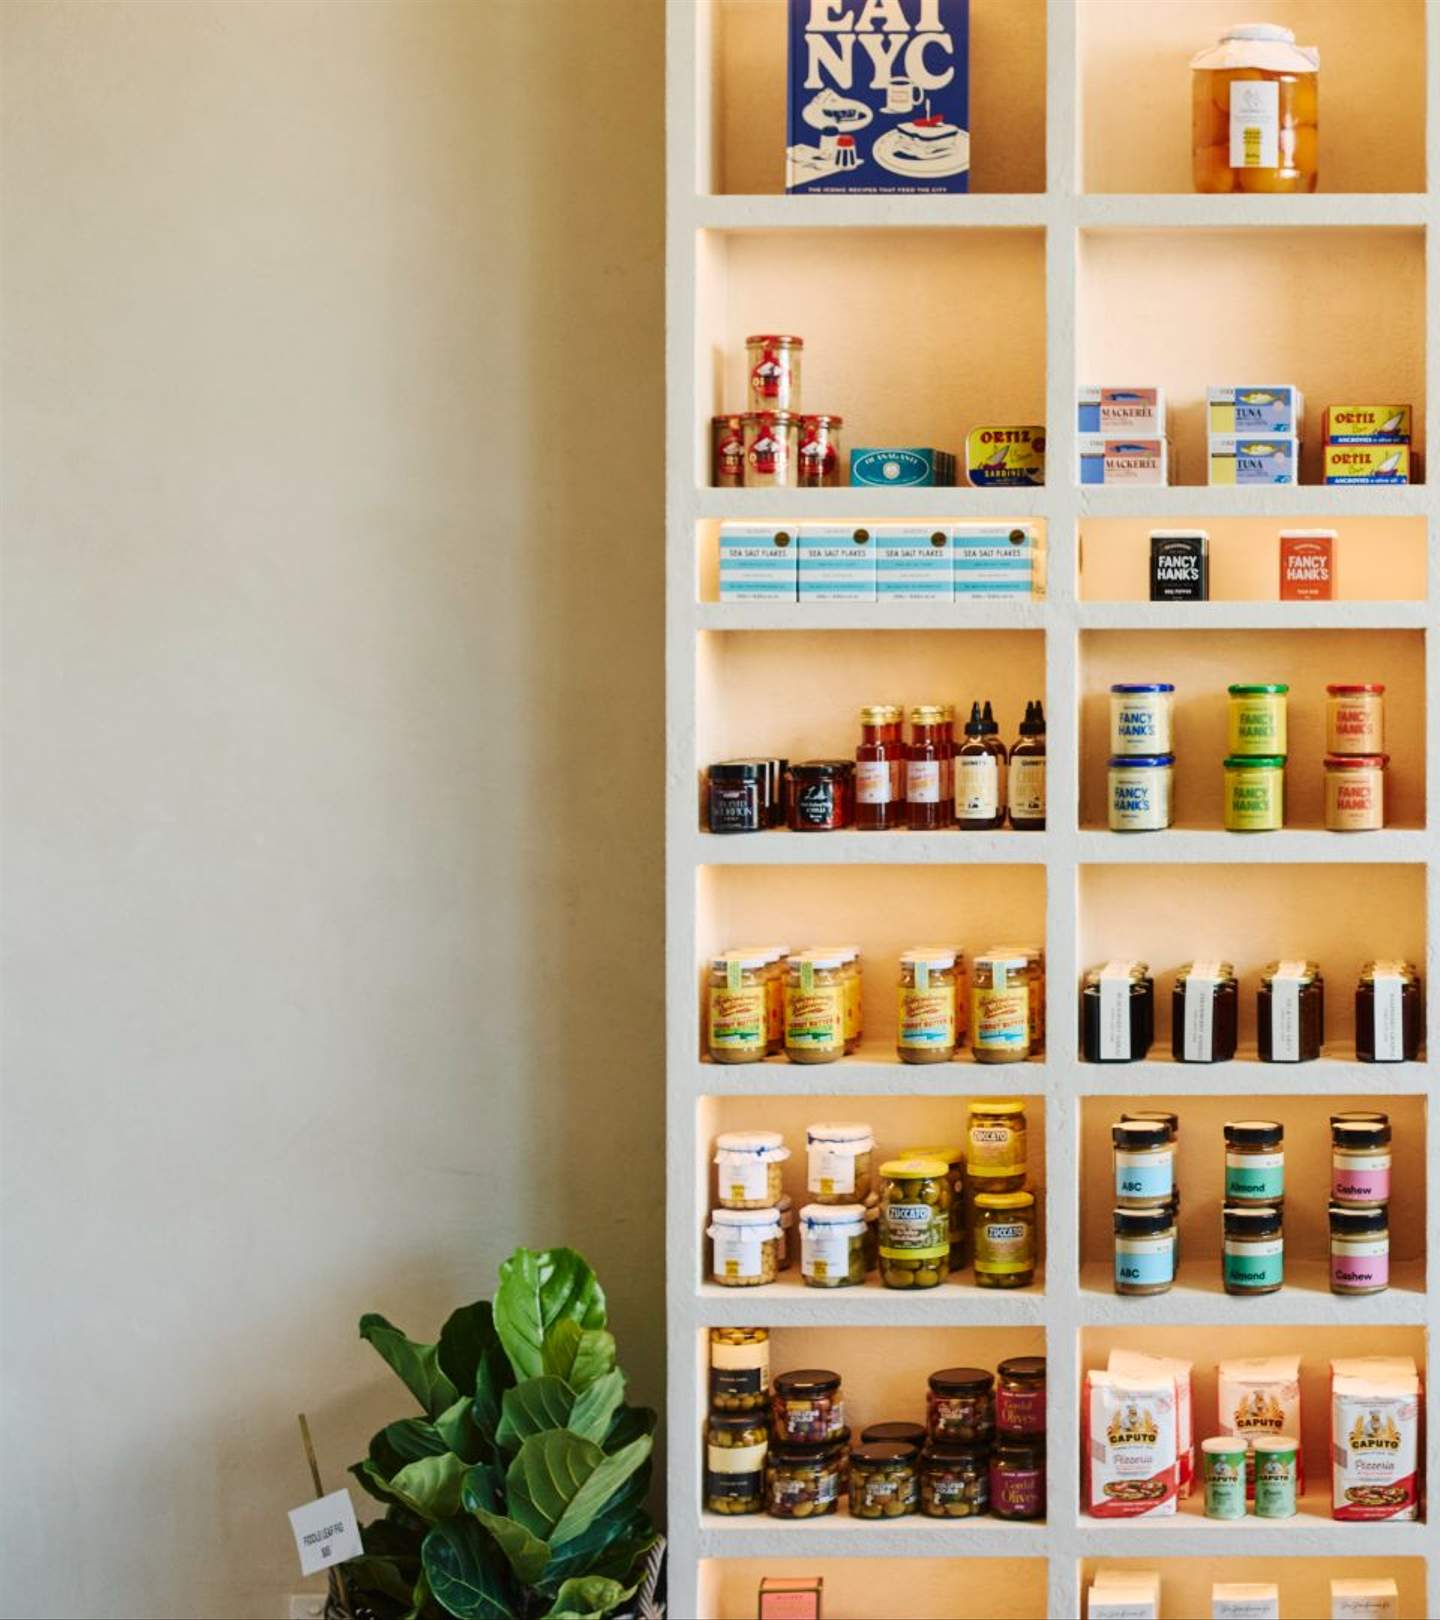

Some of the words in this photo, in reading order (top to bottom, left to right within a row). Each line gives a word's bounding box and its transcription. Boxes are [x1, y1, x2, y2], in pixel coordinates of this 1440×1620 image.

[803, 33, 955, 90] NYC
[1102, 408, 1153, 418] MACKEREL
[1236, 408, 1262, 418] TUNA
[1334, 413, 1375, 424] ORTIZ
[980, 431, 1032, 443] ORTIZ
[1332, 453, 1372, 464] ORTIZ
[1105, 460, 1157, 469] MACKEREL
[1237, 460, 1263, 469] TUNA
[729, 549, 742, 557] SEA
[744, 549, 760, 557] SALT
[762, 549, 787, 557] FLAKES
[809, 549, 821, 557] SEA
[825, 549, 839, 557] SALT
[841, 549, 866, 557] FLAKES
[886, 549, 899, 557] SEA
[901, 549, 916, 557] SALT
[918, 549, 943, 557] FLAKES
[964, 549, 977, 557] SEA
[979, 549, 994, 557] SALT
[996, 549, 1021, 557] FLAKES
[1158, 556, 1197, 568] FANCY
[1287, 556, 1327, 568] FANCY
[1119, 712, 1152, 724] FANCY
[1114, 788, 1148, 799] FANCY
[1122, 1181, 1142, 1192] ABC
[1230, 1183, 1265, 1193] Almond
[1337, 1184, 1371, 1194] Cashew
[889, 1207, 928, 1219] ZUCCATO
[988, 1226, 1024, 1237] ZUCCATO
[1120, 1269, 1140, 1279] ABC
[1230, 1271, 1265, 1280] Almond
[1336, 1270, 1373, 1280] Cashew
[1237, 1418, 1283, 1428] CAPUTO
[1109, 1434, 1157, 1443] CAPUTO
[1352, 1440, 1399, 1449] CAPUTO
